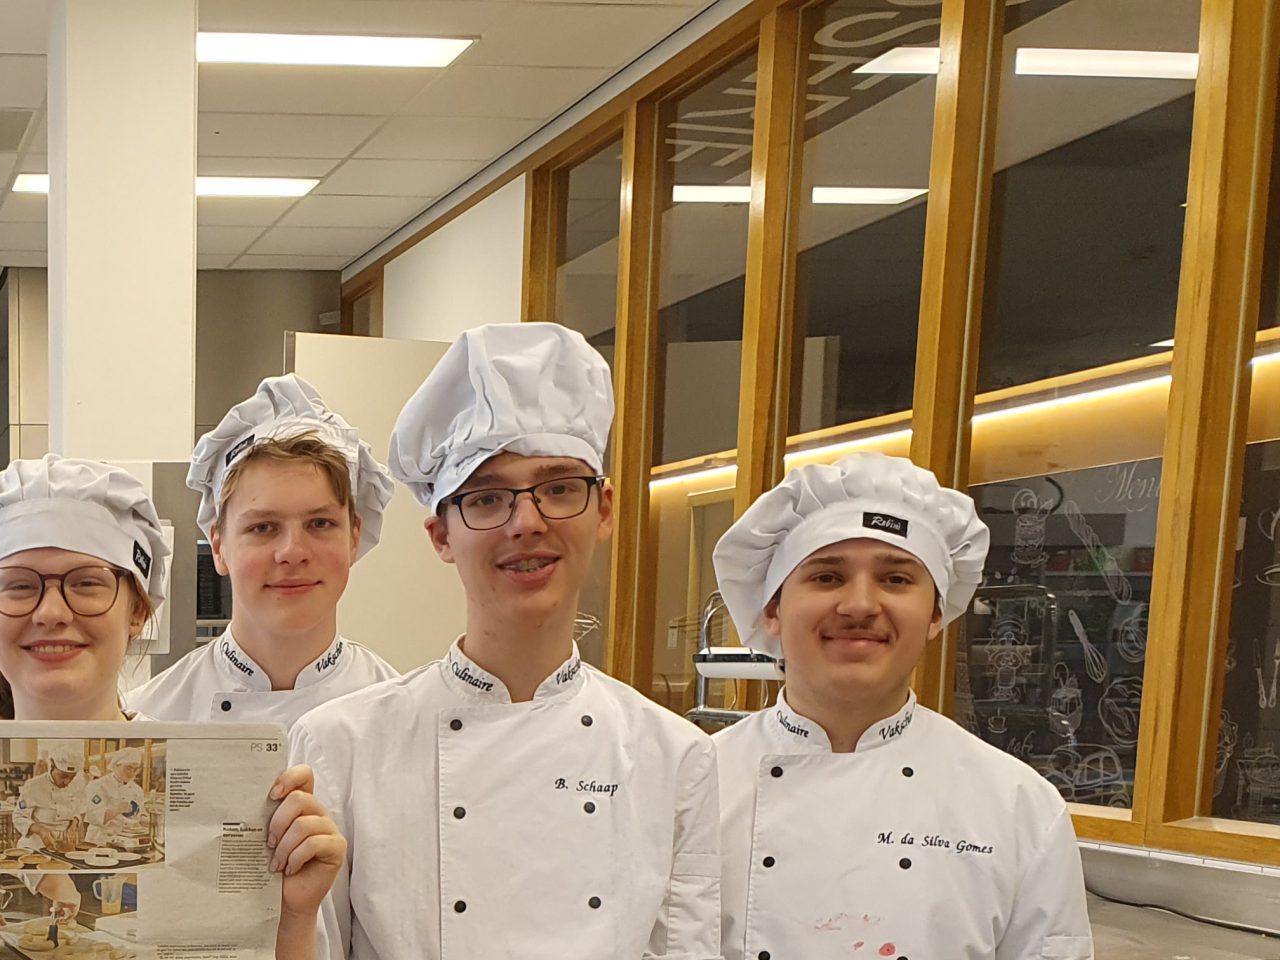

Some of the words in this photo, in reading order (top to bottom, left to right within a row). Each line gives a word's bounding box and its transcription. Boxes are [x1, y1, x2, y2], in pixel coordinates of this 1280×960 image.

[451, 661, 494, 692] Culinaire
[250, 742, 263, 752] PS
[554, 778, 568, 789] B.
[576, 780, 619, 797] Schaap
[877, 831, 894, 844] M.
[900, 833, 914, 845] da
[921, 835, 950, 848] Silva
[956, 840, 994, 854] Gomes
